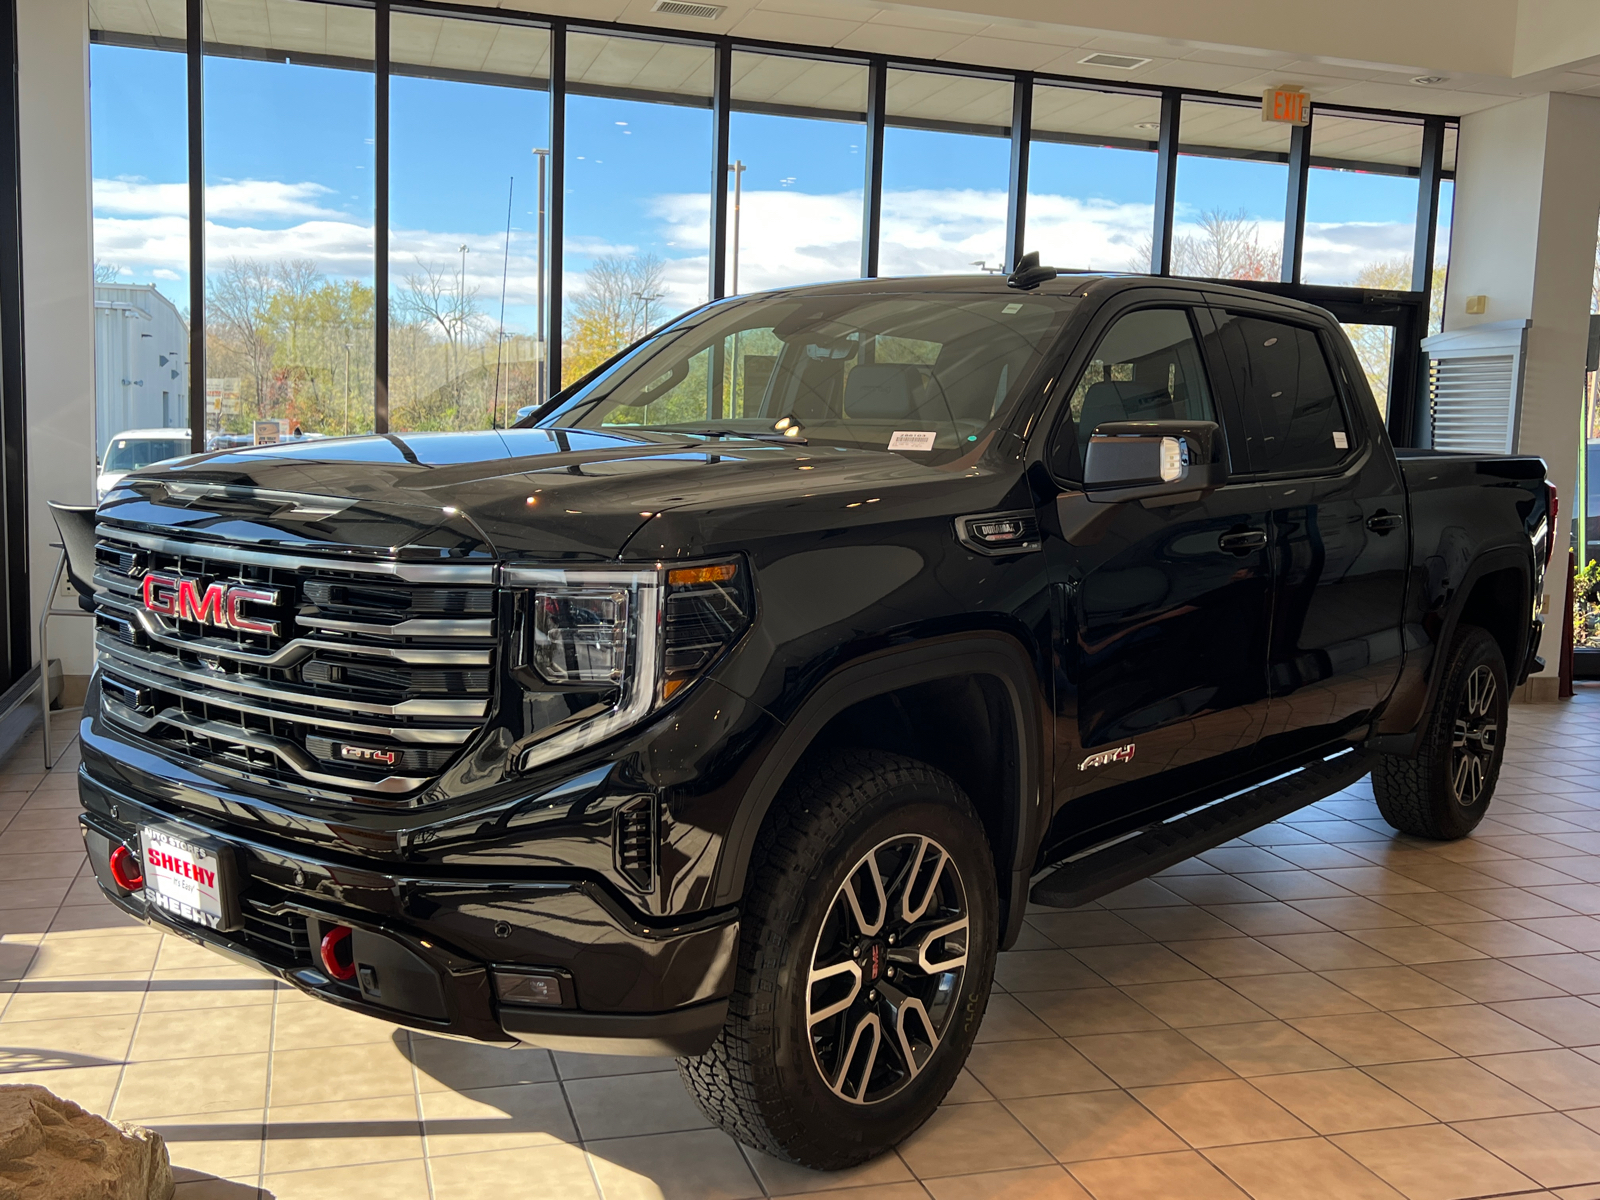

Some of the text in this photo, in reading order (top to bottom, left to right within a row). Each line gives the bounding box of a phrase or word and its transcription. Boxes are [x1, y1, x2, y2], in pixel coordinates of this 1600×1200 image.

[1273, 91, 1305, 122] EXIT
[143, 573, 281, 637] GMC
[341, 746, 395, 765] AT4
[1078, 743, 1136, 771] AT4
[144, 827, 168, 843] AUTO
[147, 848, 215, 889] SHEEHY
[145, 888, 220, 929] SHEEHY
